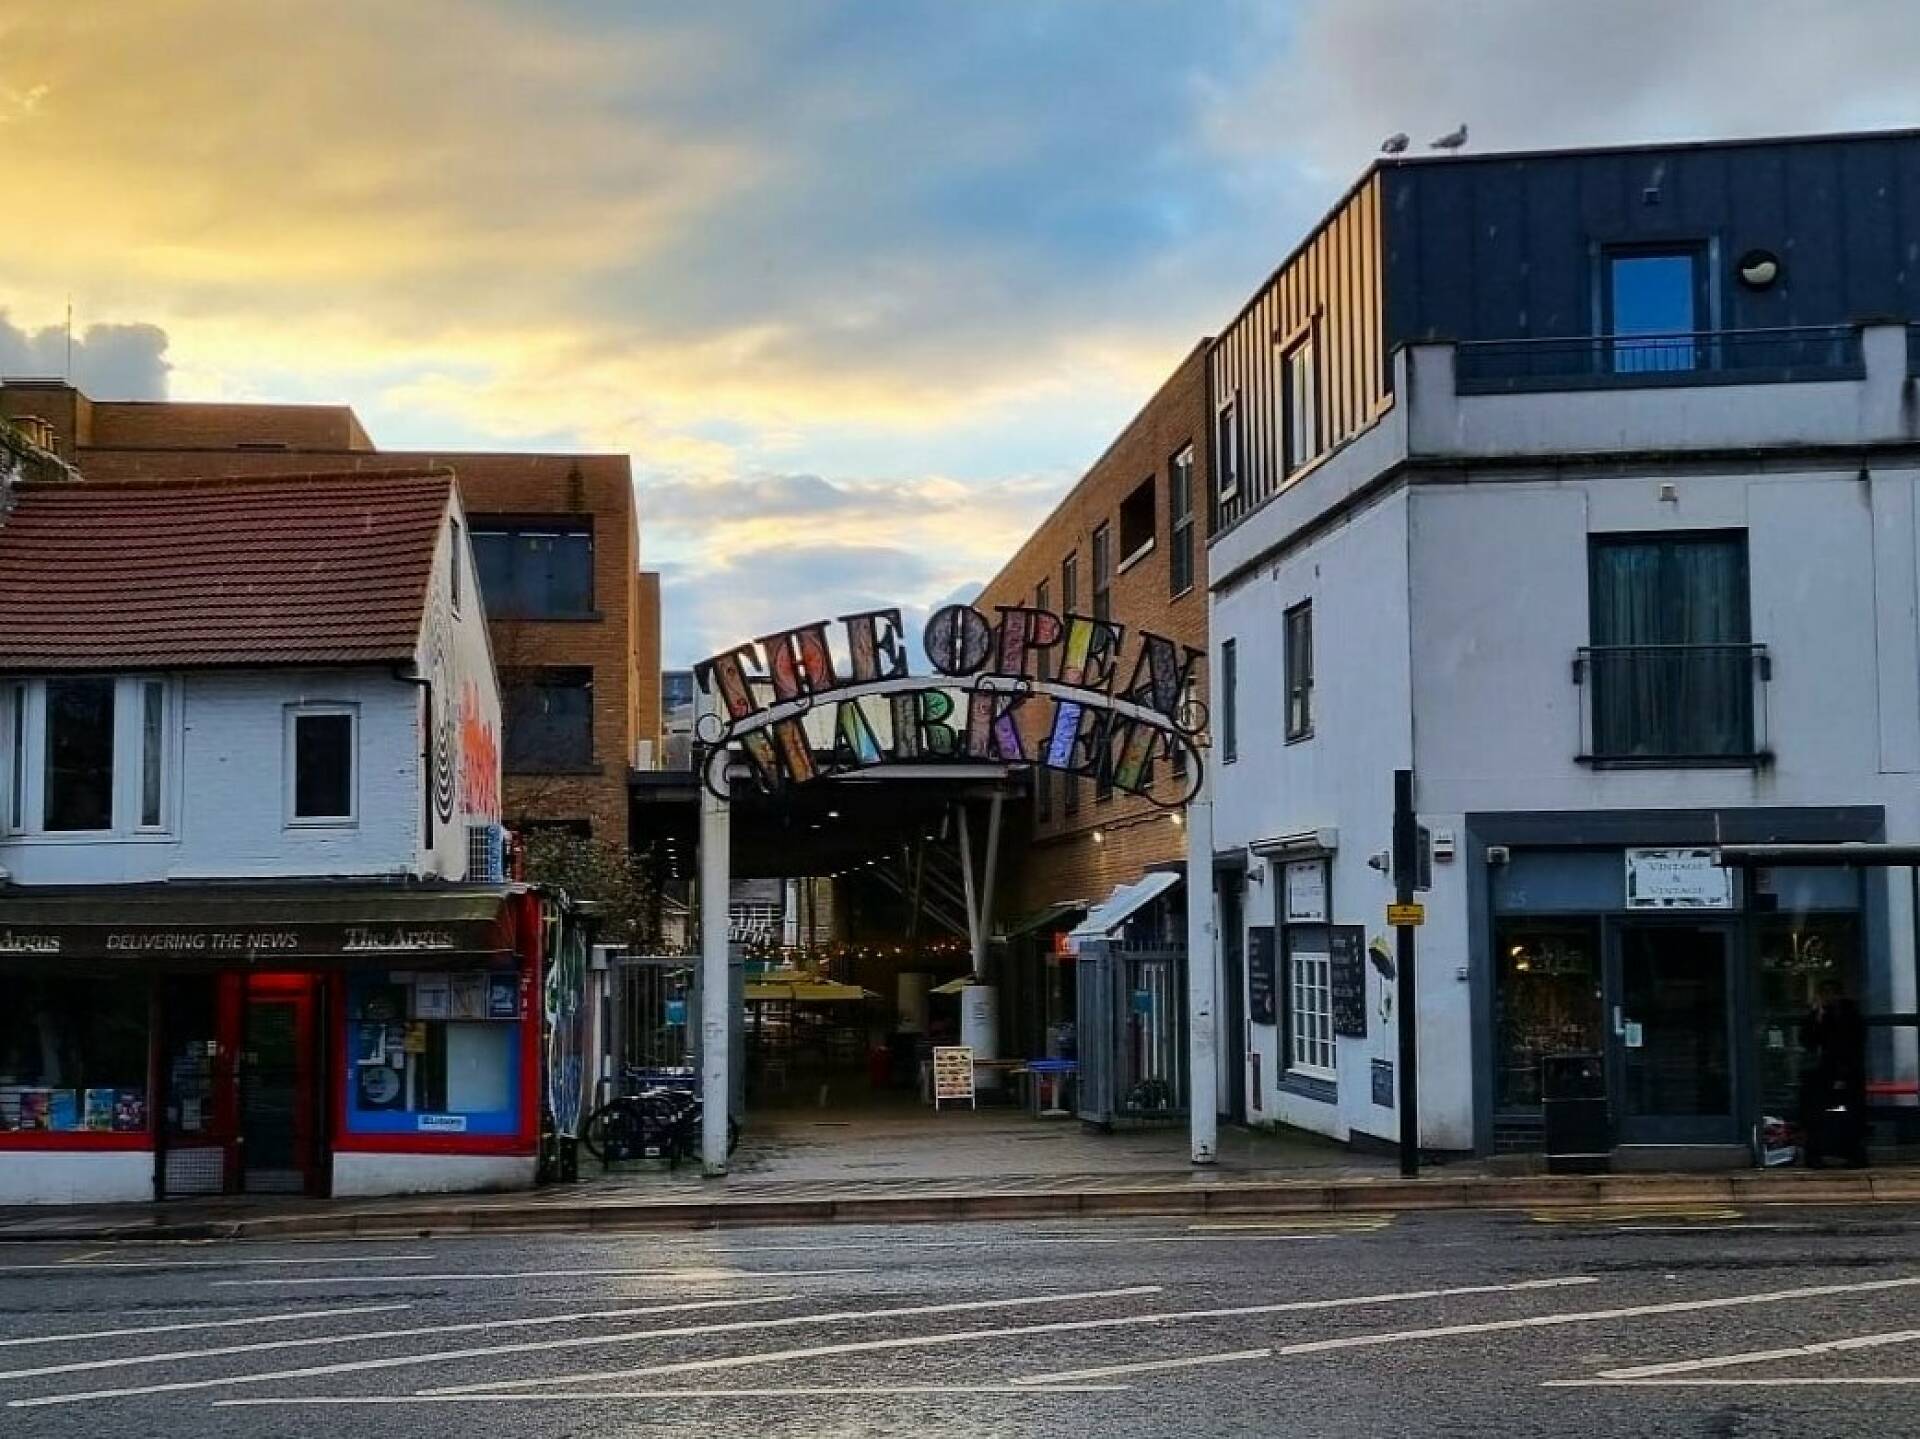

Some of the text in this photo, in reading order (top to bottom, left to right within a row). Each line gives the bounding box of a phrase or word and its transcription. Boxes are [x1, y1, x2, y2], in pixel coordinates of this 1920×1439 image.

[694, 604, 1206, 720] THE OPEN
[732, 687, 1188, 799] MARKET
[106, 932, 299, 950] DELIVERING THE NEWS
[342, 927, 454, 949] The Argus
